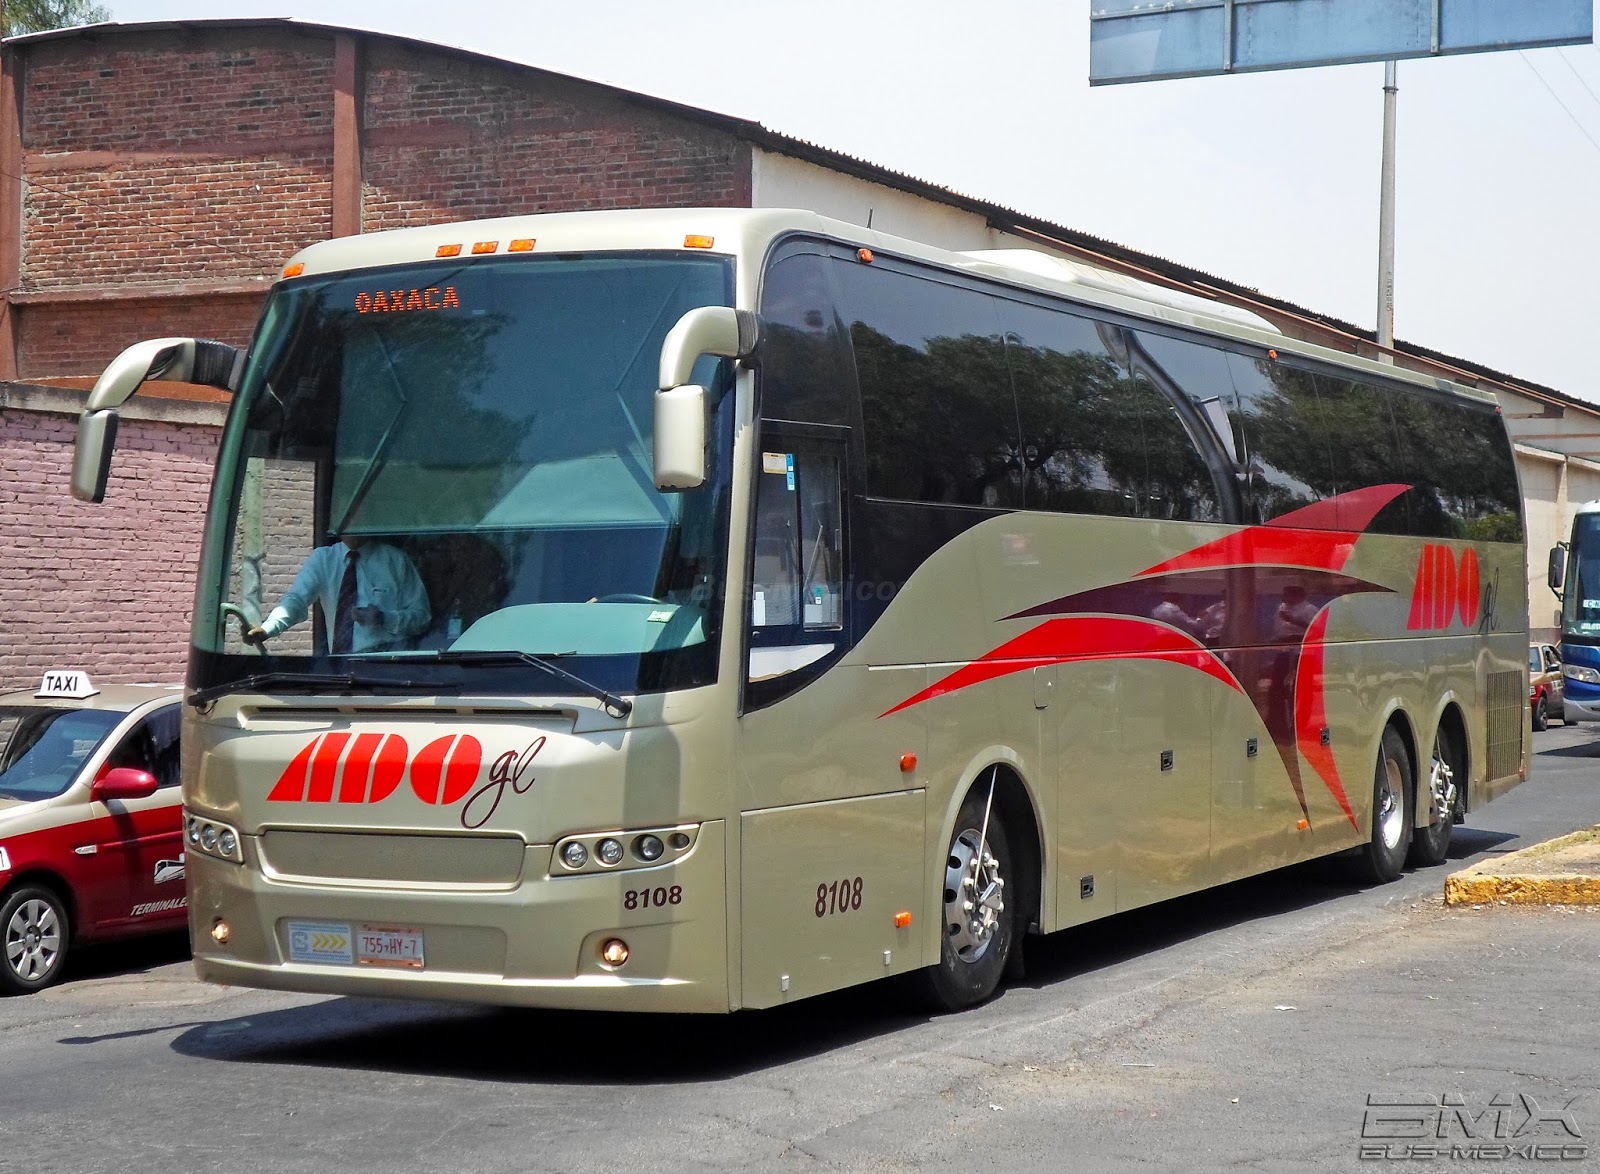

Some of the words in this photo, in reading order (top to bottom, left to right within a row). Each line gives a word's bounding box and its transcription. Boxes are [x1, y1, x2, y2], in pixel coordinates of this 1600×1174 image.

[355, 286, 459, 314] OAXACA
[1406, 543, 1480, 631] ADO
[46, 675, 78, 691] TAXI
[267, 732, 482, 806] ADO
[461, 736, 547, 829] gl
[130, 896, 188, 916] TERMINALE
[624, 885, 683, 911] 8108
[815, 876, 863, 918] 8108
